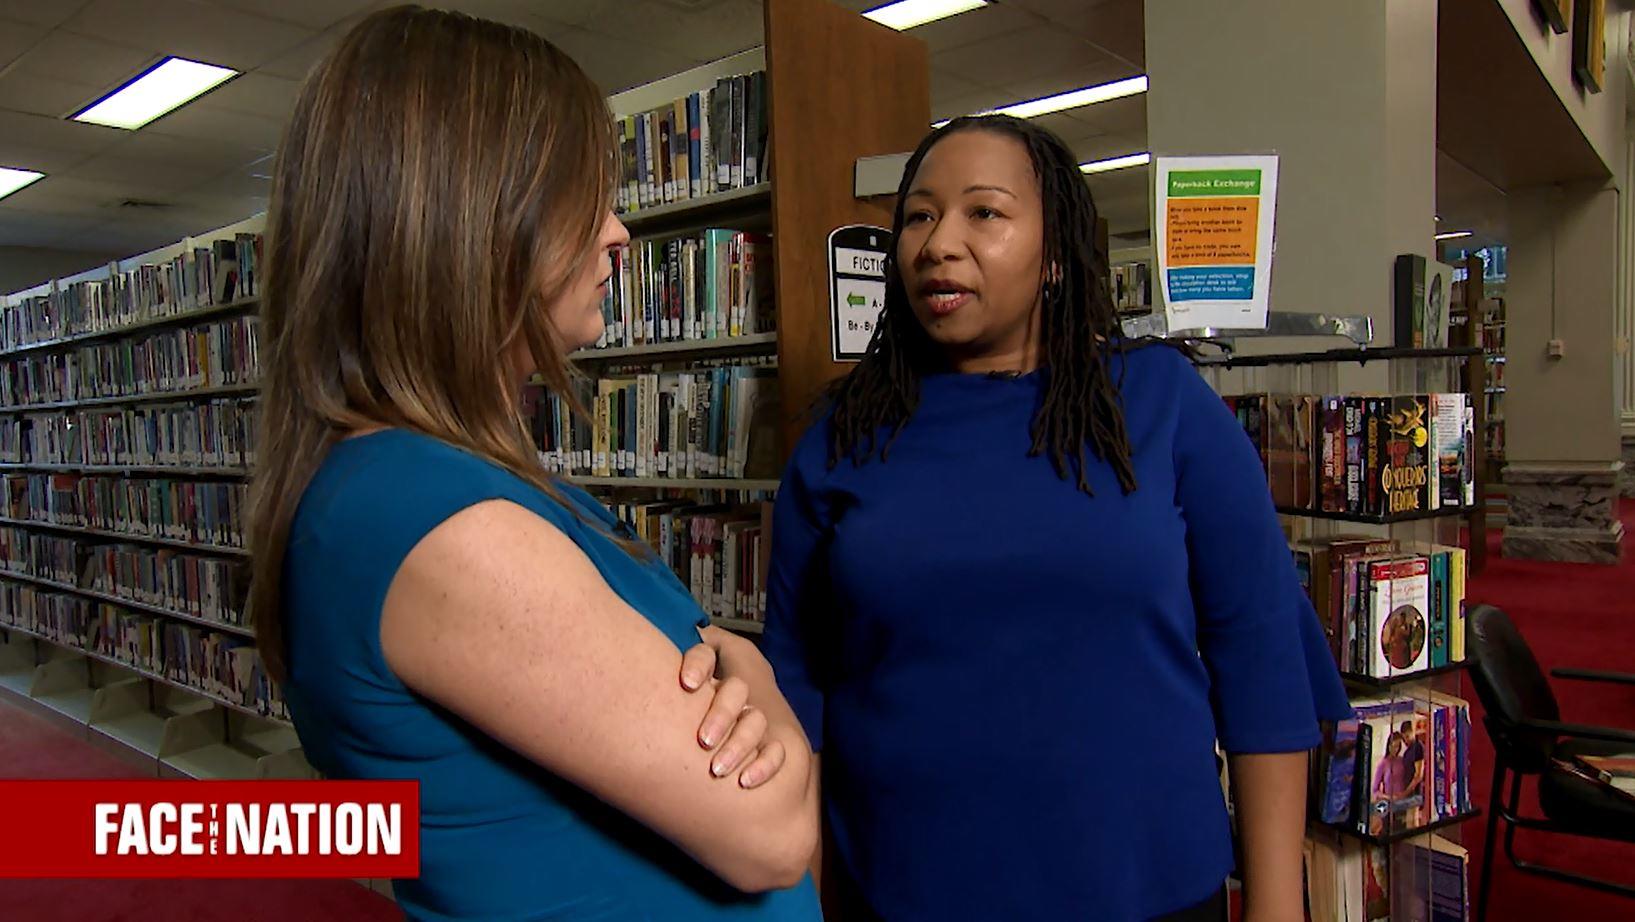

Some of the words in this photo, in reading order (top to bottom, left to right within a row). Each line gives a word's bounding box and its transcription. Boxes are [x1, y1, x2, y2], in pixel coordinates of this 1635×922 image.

[1213, 179, 1256, 188] Exchange
[853, 256, 886, 271] FICTIO
[872, 298, 878, 308] A
[848, 320, 858, 331] Be
